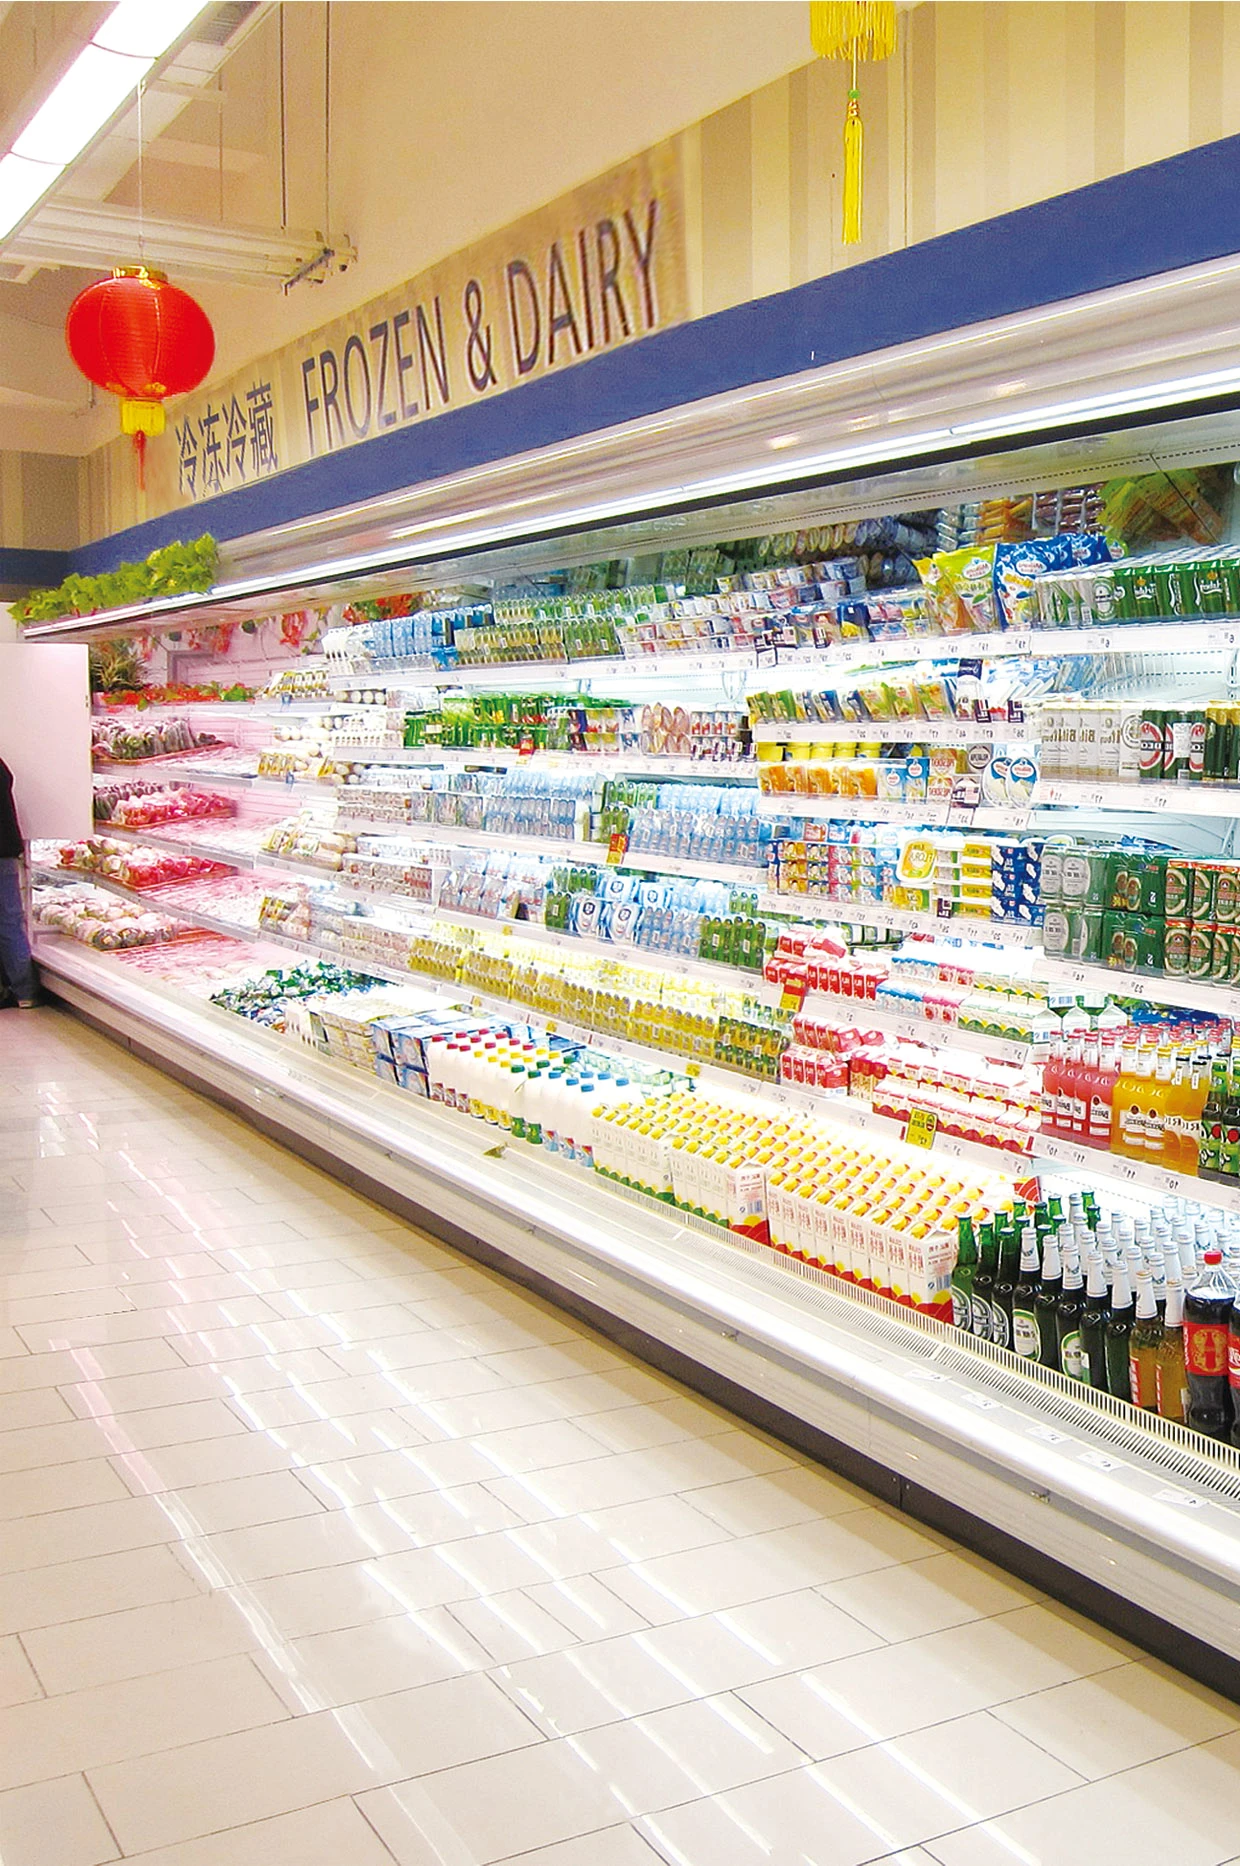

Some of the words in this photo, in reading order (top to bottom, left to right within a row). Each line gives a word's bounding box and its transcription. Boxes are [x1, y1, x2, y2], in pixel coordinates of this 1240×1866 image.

[301, 296, 450, 459] FROZEN
[464, 280, 498, 394] &
[504, 199, 661, 379] DAIRY
[174, 381, 279, 500] 冷冻冷藏
